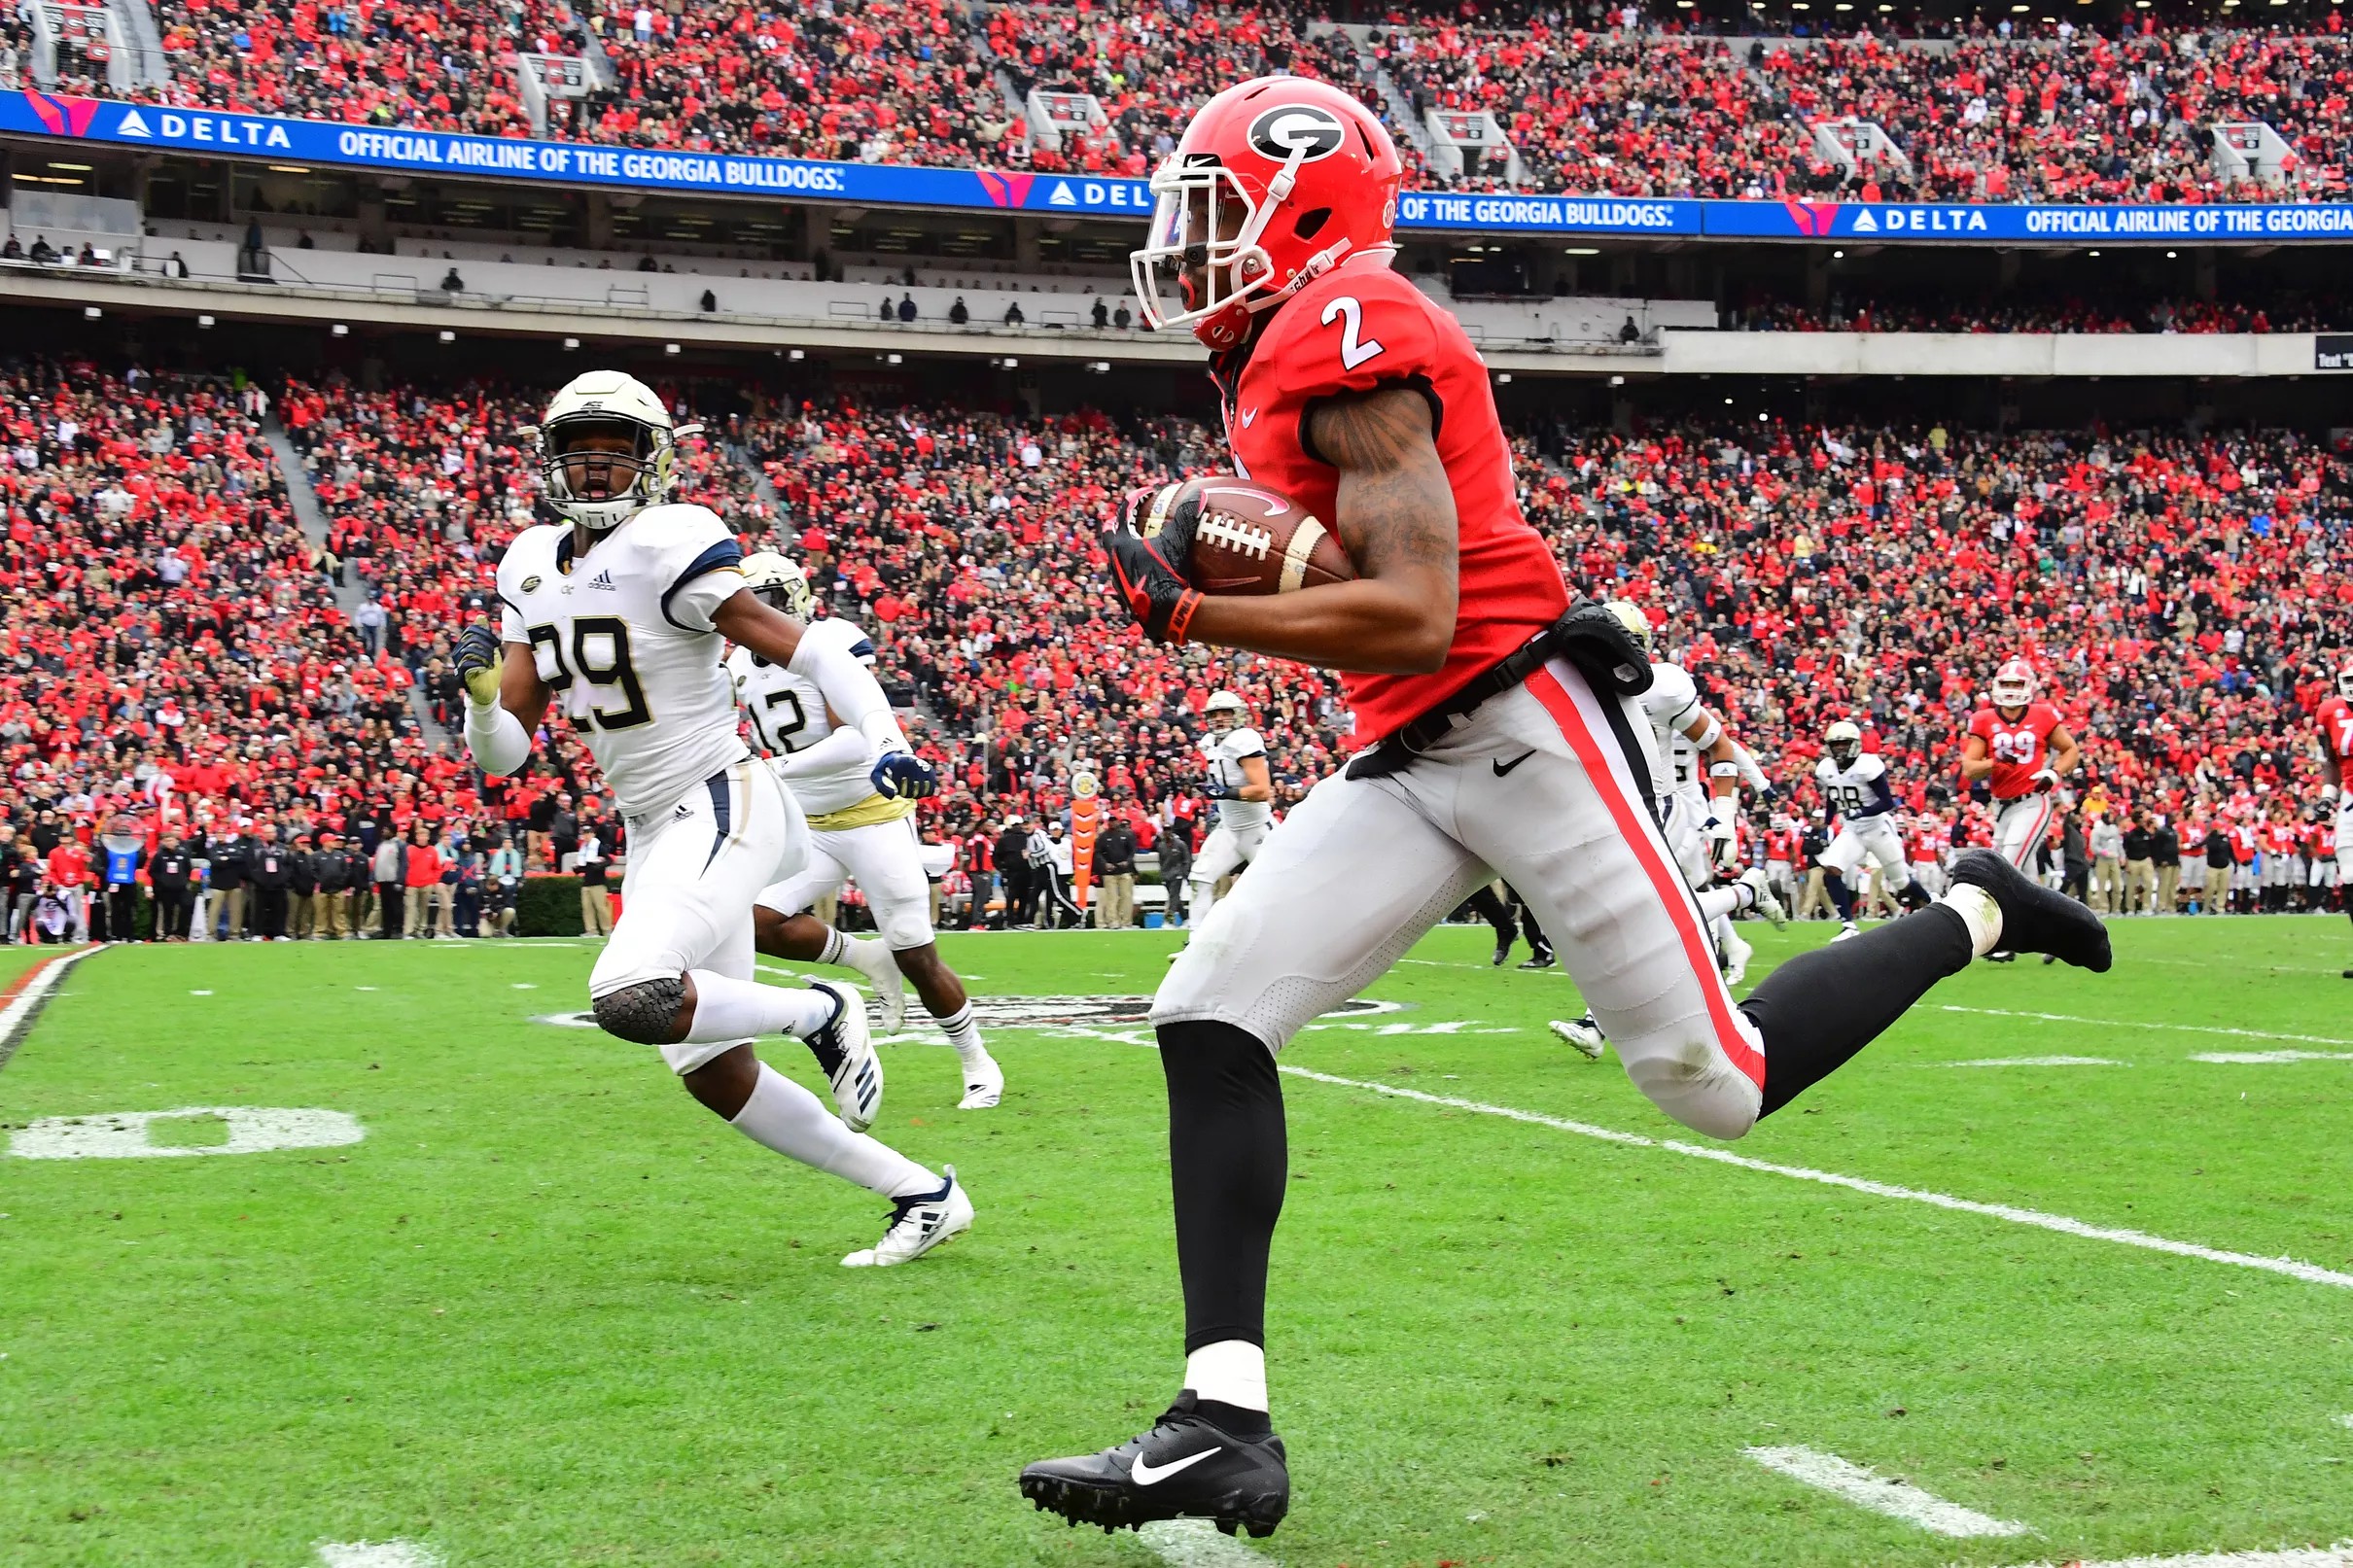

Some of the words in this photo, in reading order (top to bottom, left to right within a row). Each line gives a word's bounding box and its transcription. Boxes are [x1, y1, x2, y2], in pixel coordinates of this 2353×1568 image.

[160, 114, 292, 149] DELTA
[1260, 109, 1345, 156] G
[339, 131, 443, 163] OFFICIAL
[446, 140, 537, 170] AIRLINE
[540, 148, 571, 173] OF
[575, 151, 619, 176] THE
[622, 155, 722, 183] GEORGIA
[1084, 183, 1150, 207] DEL
[1402, 197, 1429, 221] OF
[1432, 199, 1472, 222] THE
[1475, 200, 1563, 224] GEORGIA
[1886, 209, 1987, 231] DELTA
[2025, 210, 2111, 232] OFFICIAL
[2114, 210, 2191, 232] AIRLINE
[2194, 210, 2221, 232] OF
[2224, 210, 2264, 231] THE
[2266, 209, 2353, 231] GEORGIA
[1319, 295, 1387, 371] 2
[526, 614, 655, 734] 29
[747, 688, 807, 757] 12
[2337, 718, 2353, 756] 7
[1992, 730, 2036, 765] 89
